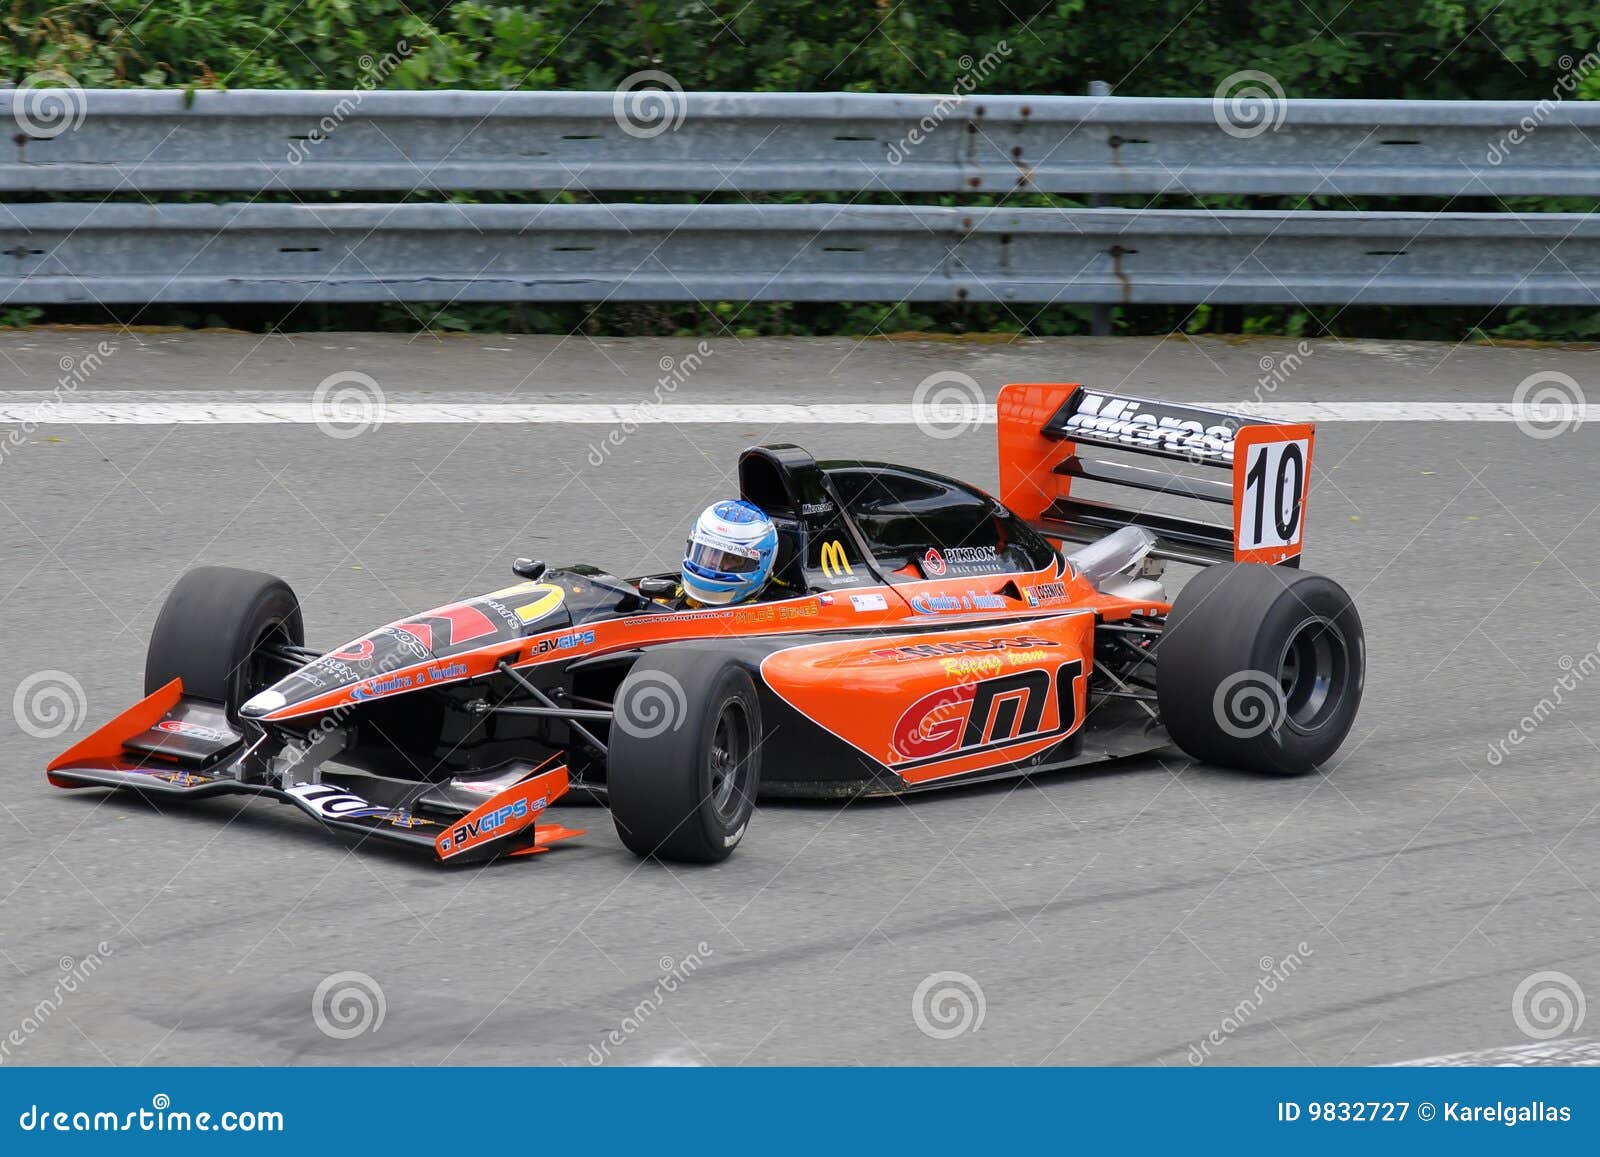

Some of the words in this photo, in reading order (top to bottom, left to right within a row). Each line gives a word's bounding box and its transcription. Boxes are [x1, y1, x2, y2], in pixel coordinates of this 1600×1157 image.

[1246, 443, 1305, 545] 10
[944, 546, 996, 563] PIKRON
[539, 630, 595, 653] BVGIPS
[940, 654, 1002, 678] Racing
[1008, 649, 1048, 666] team
[369, 677, 413, 695] Vondra
[416, 672, 425, 684] a
[428, 663, 467, 680] Vondra
[453, 797, 528, 846] BVGIPS
